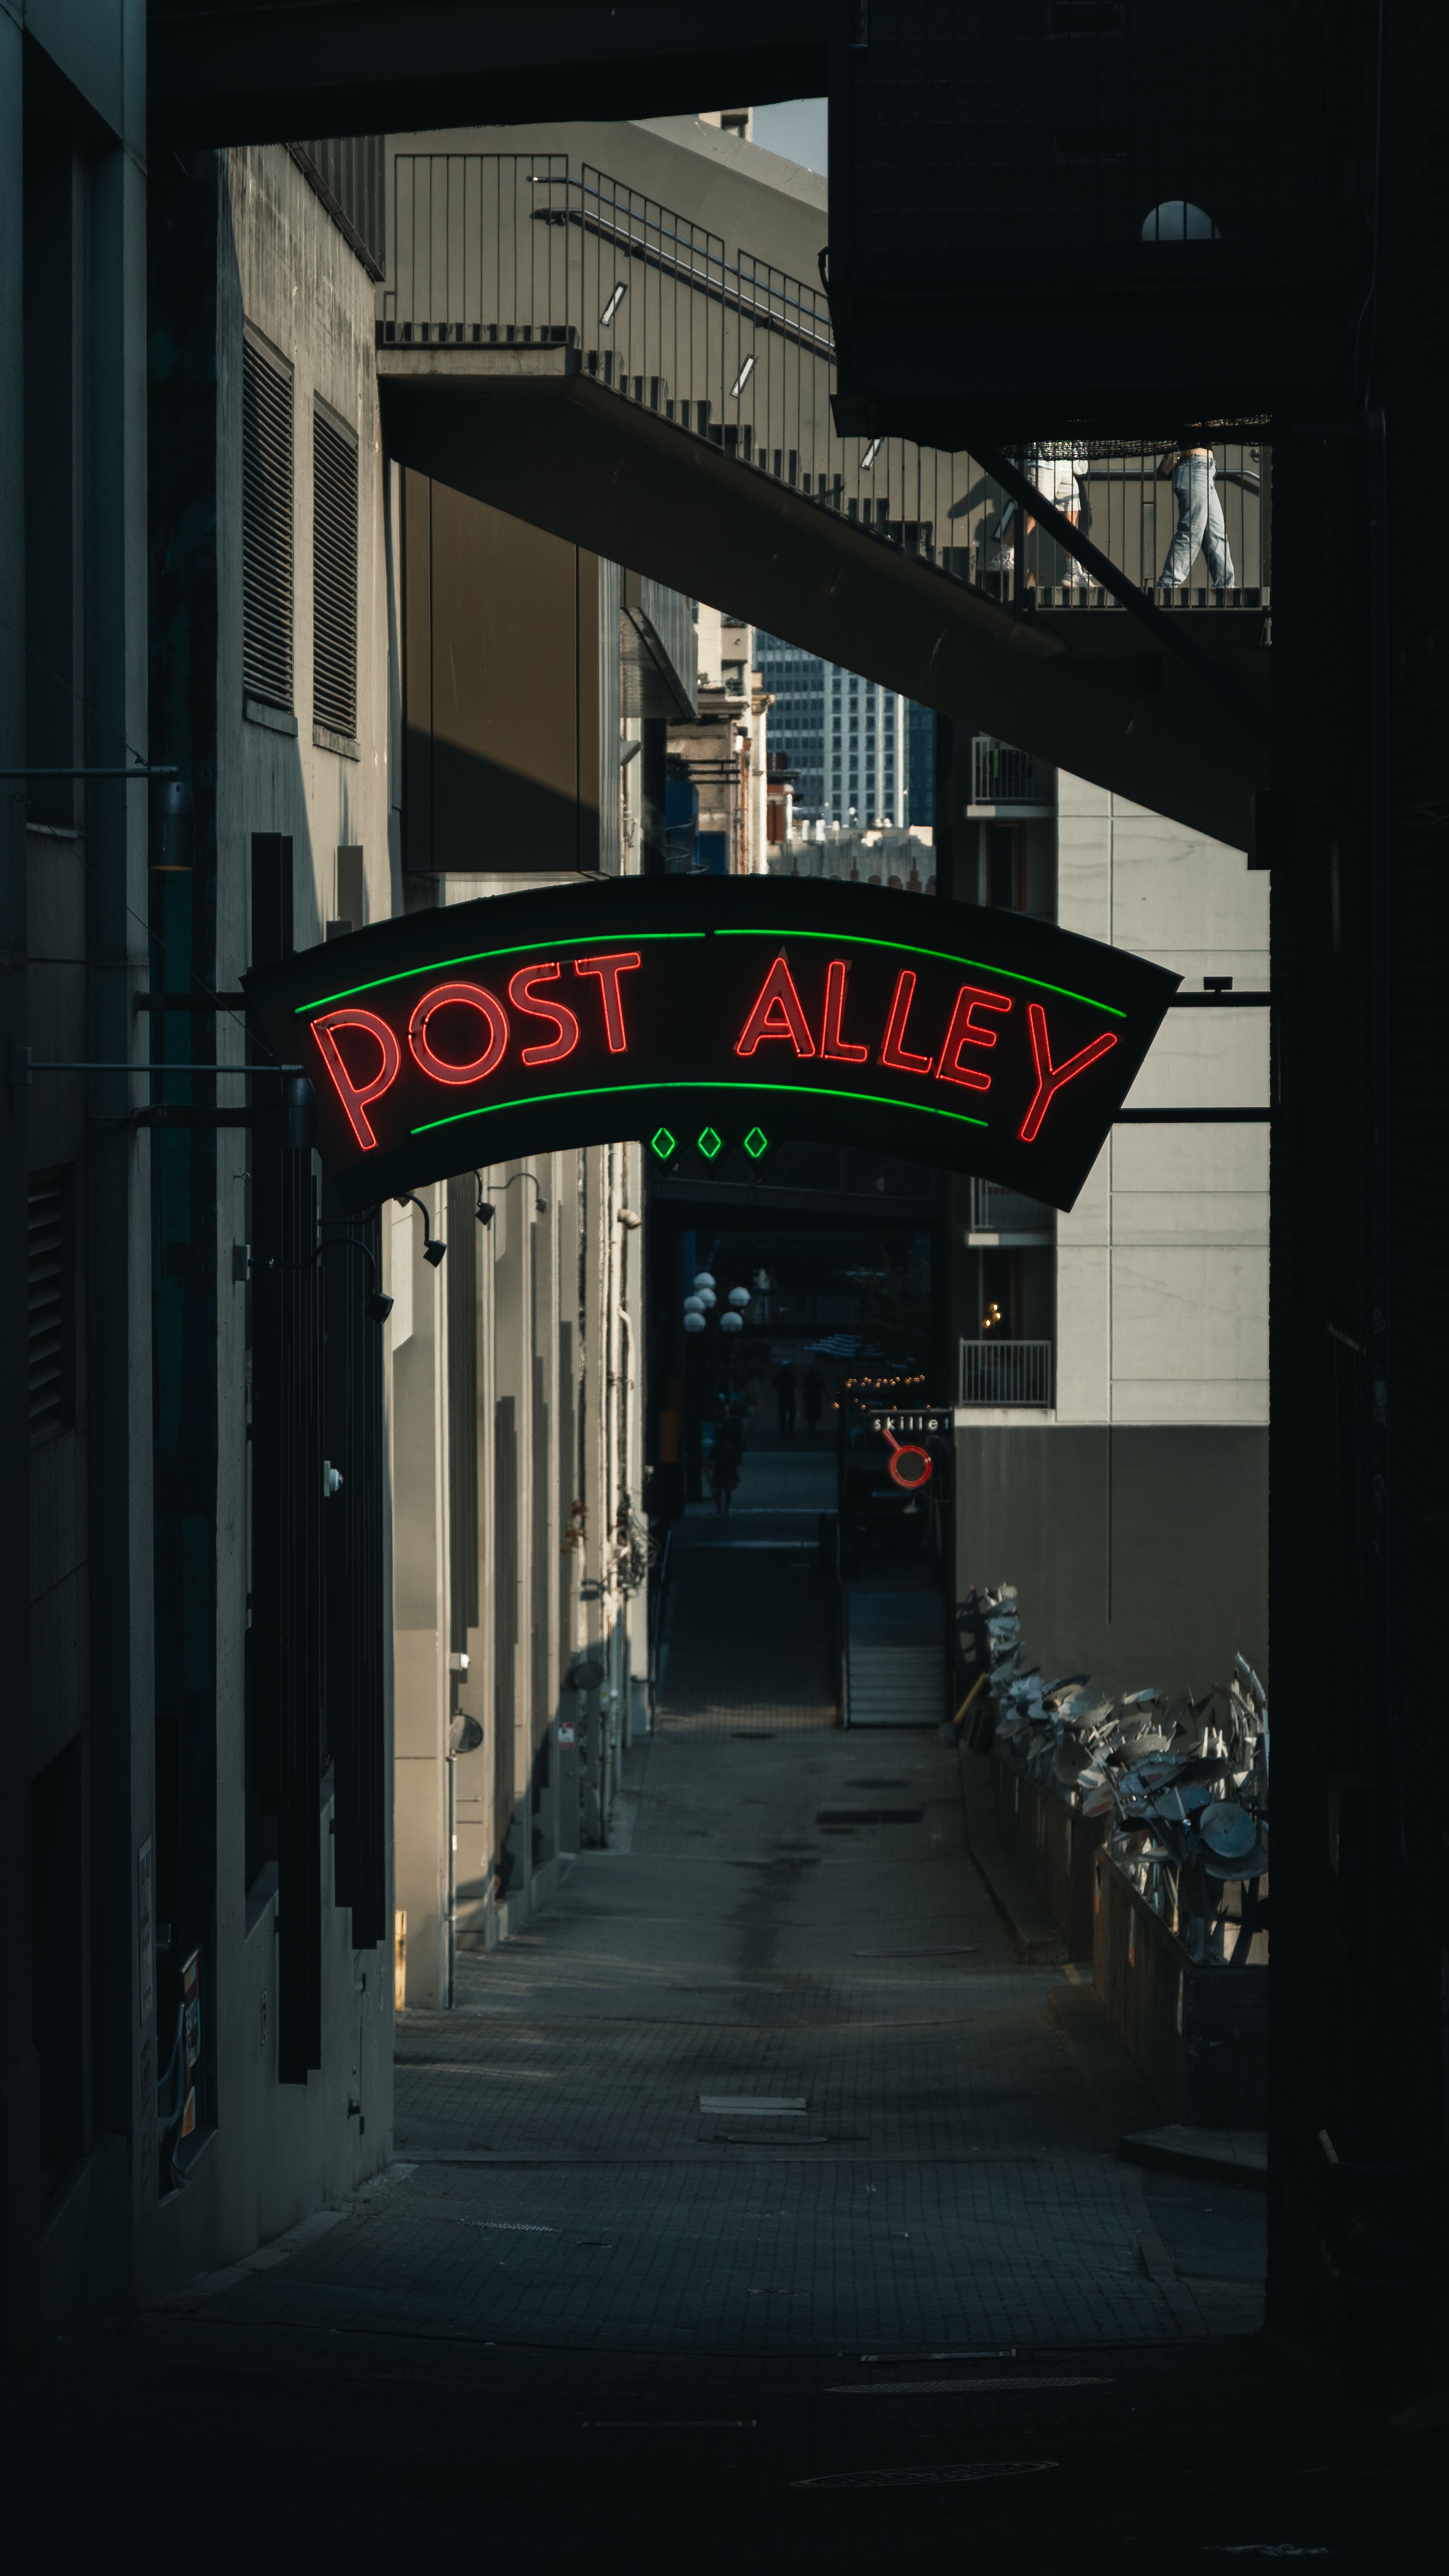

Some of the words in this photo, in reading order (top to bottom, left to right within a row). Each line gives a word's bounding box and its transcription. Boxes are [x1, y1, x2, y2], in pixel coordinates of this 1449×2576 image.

[309, 951, 641, 1151] POST
[735, 956, 1118, 1142] ALLEY
[873, 1416, 950, 1431] skillet
